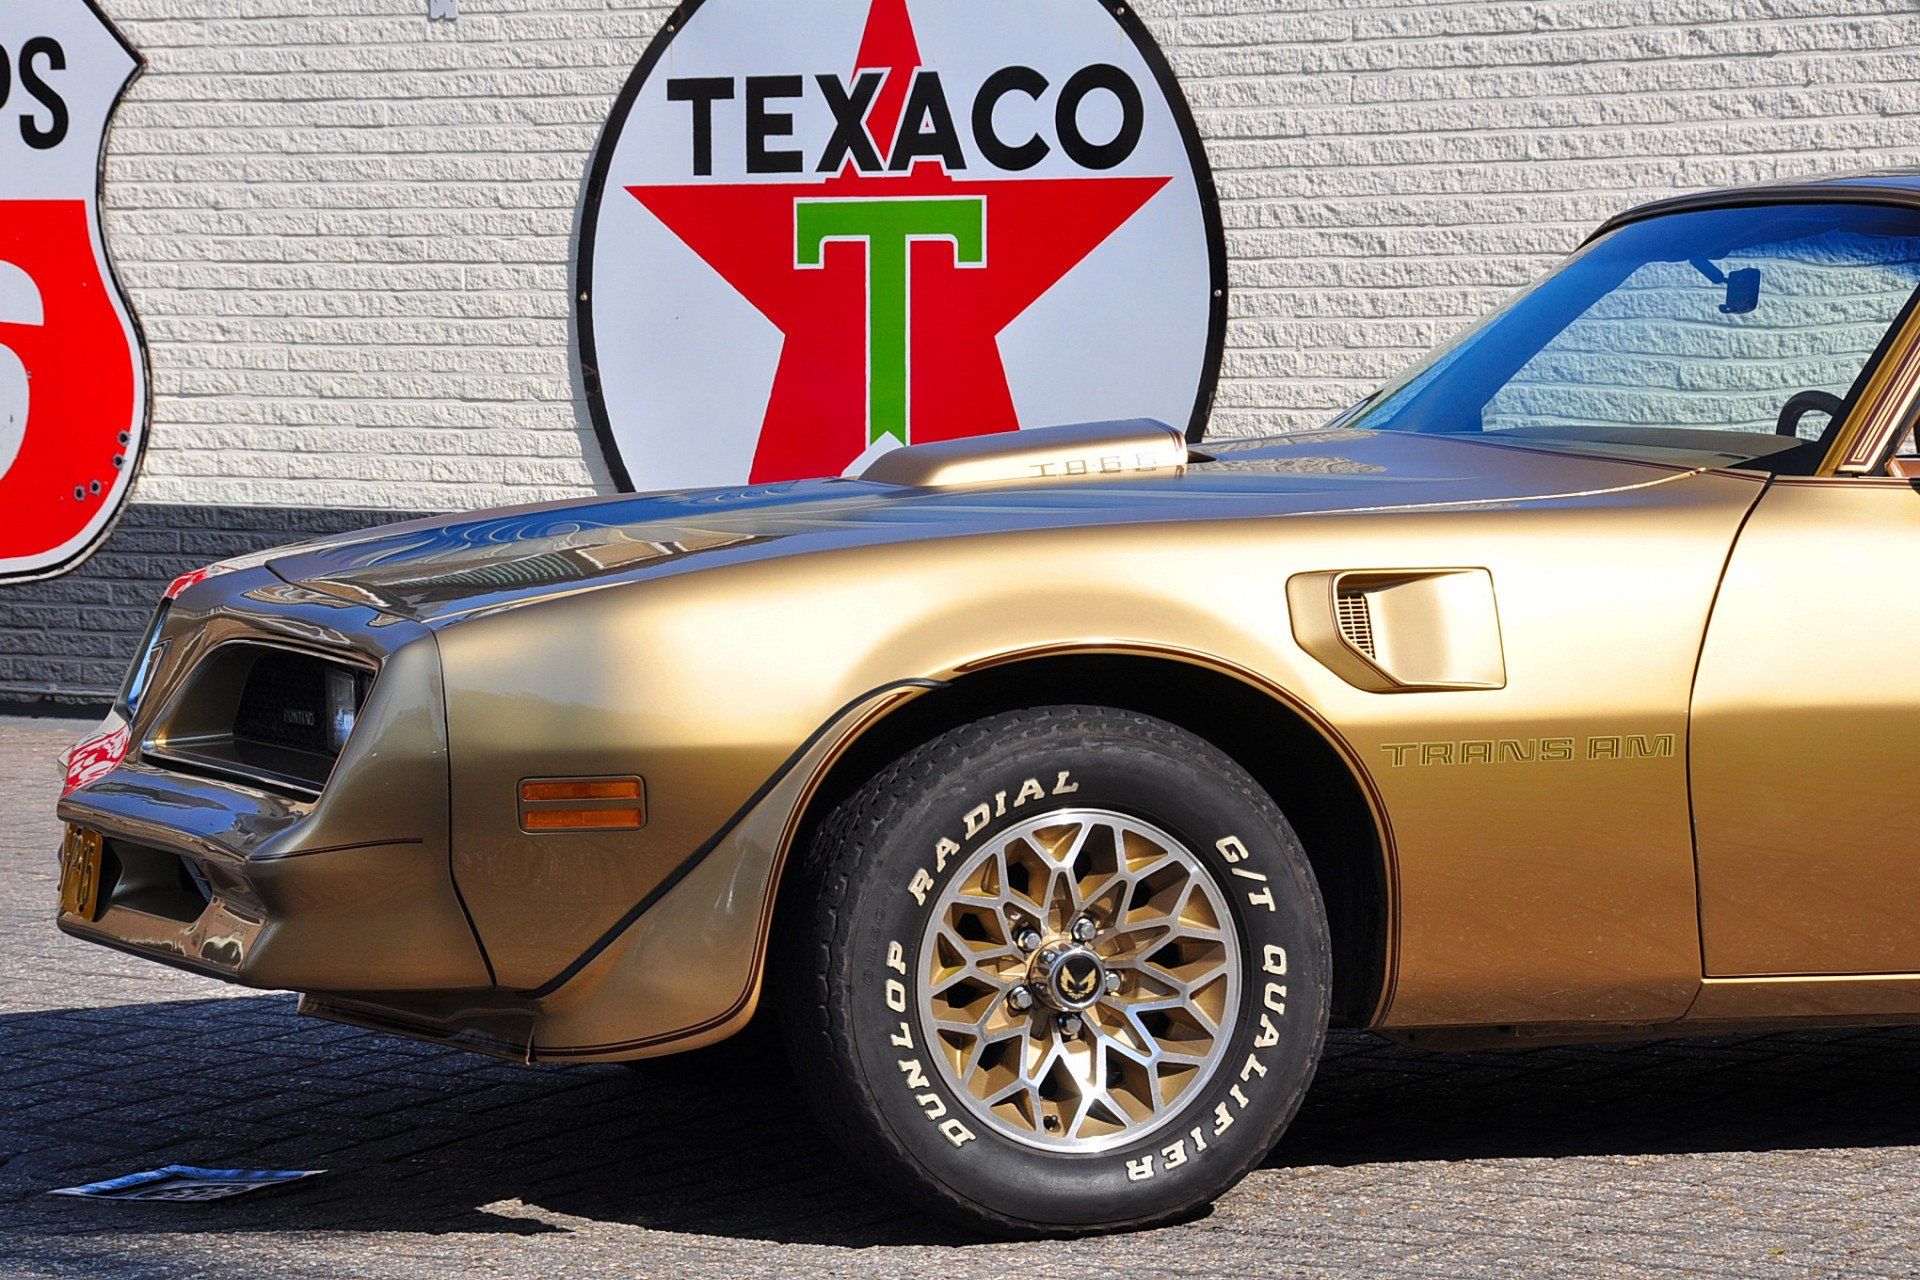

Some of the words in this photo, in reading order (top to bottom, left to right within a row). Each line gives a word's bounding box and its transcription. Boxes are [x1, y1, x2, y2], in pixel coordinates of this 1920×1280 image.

[667, 63, 1144, 176] TEXACO
[795, 196, 986, 446] T
[1381, 738, 1575, 768] TRANS
[1586, 733, 1676, 760] AM
[907, 770, 1079, 906] RADIAL
[1215, 835, 1276, 913] G/T
[886, 941, 976, 1148] DUNLOP
[1125, 944, 1288, 1182] QUALIFIER
